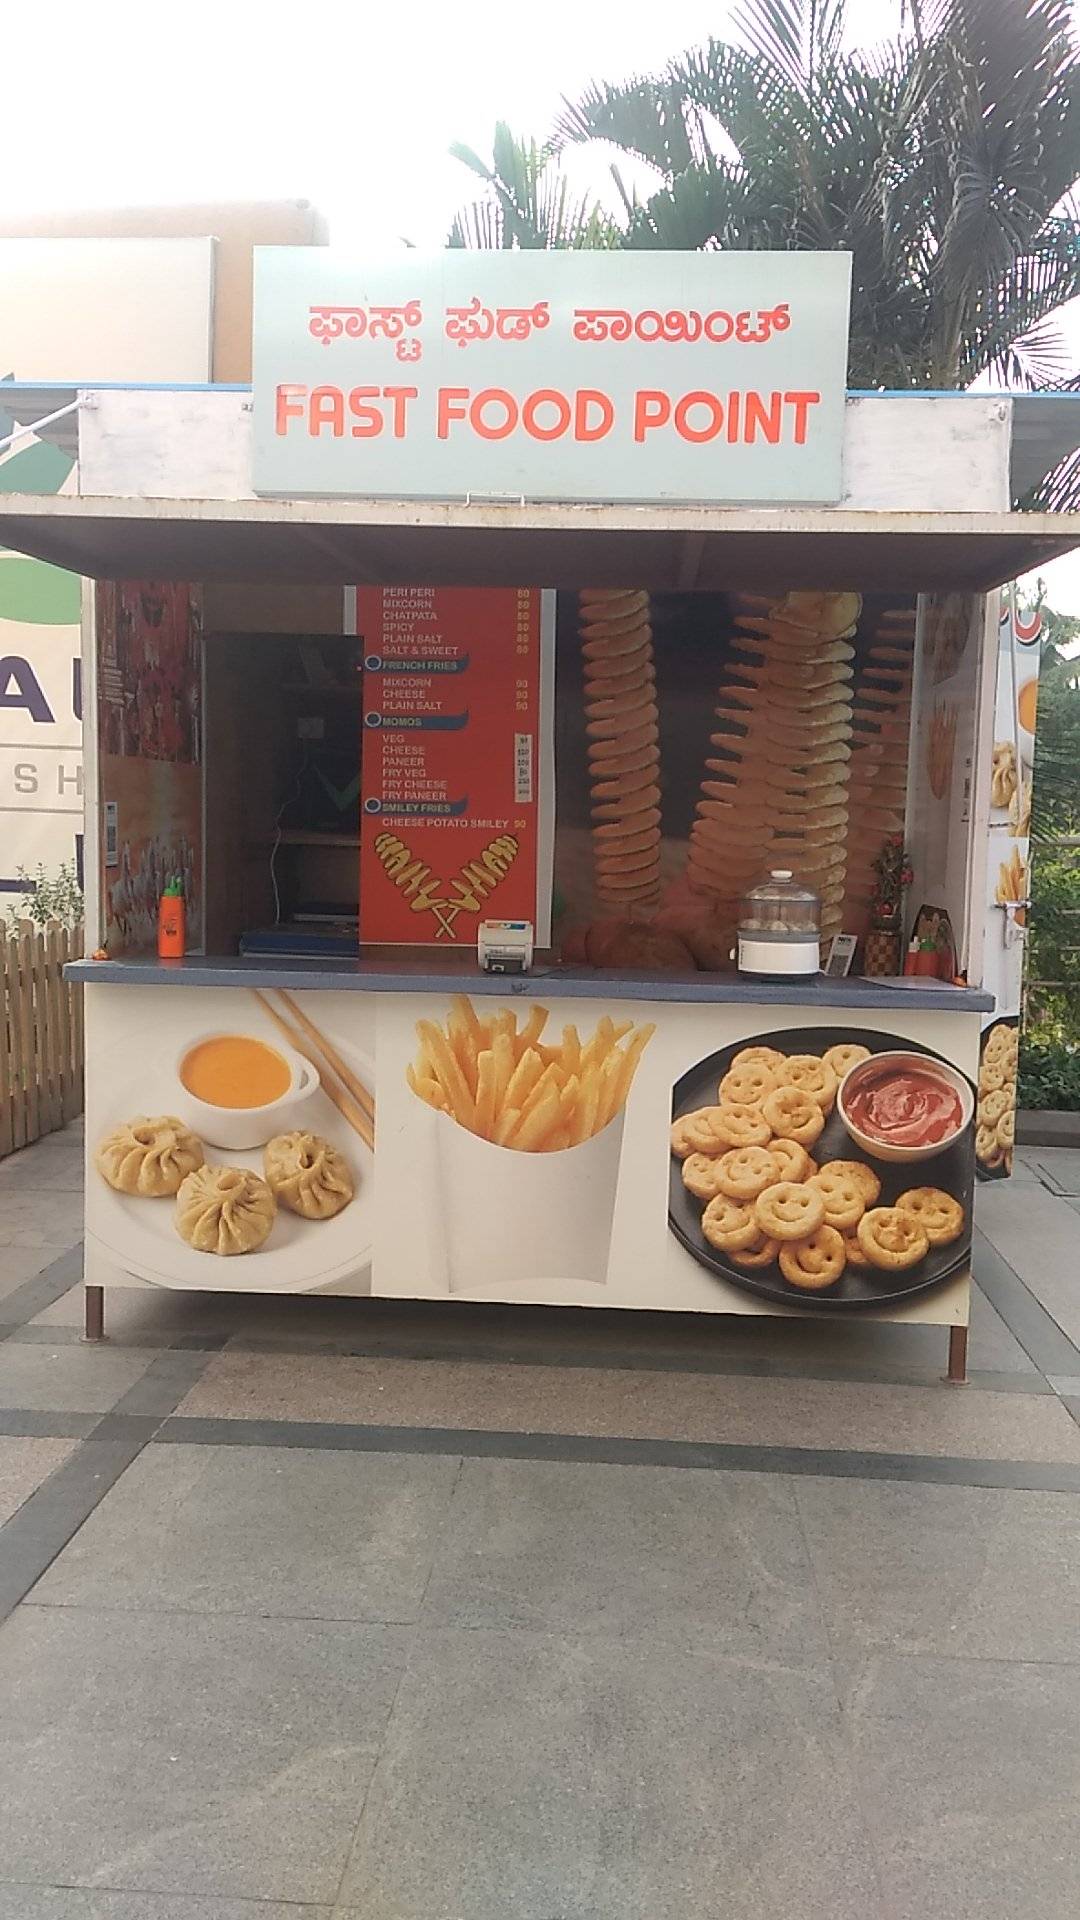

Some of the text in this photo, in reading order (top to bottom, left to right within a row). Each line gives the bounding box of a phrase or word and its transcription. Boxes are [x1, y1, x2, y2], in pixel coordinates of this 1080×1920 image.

[309, 299, 422, 361] ಫಾಸ್ಟ್
[573, 303, 791, 343] ಪಾಯಿಂಟ್
[276, 384, 820, 444] FAST FOOD POINT
[382, 588, 408, 597] PERI
[410, 588, 435, 597] PERI
[382, 661, 457, 671] FRENCH FRIES
[0, 655, 83, 724] A
[382, 689, 425, 699] CHEESE
[382, 701, 414, 710] PLAIN
[382, 717, 422, 727] MOMOS
[382, 734, 405, 744] VEG
[382, 745, 425, 755] CHEESE
[382, 757, 425, 767] PANEER
[382, 768, 427, 778] FRY VEG
[382, 780, 448, 789] FRY CHEESE
[382, 791, 447, 801] FRY PANEER
[382, 803, 451, 813] SMILEY FRIES
[382, 817, 425, 828] CHEESE
[427, 818, 469, 828] POTATO
[471, 818, 510, 829] SMILEY
